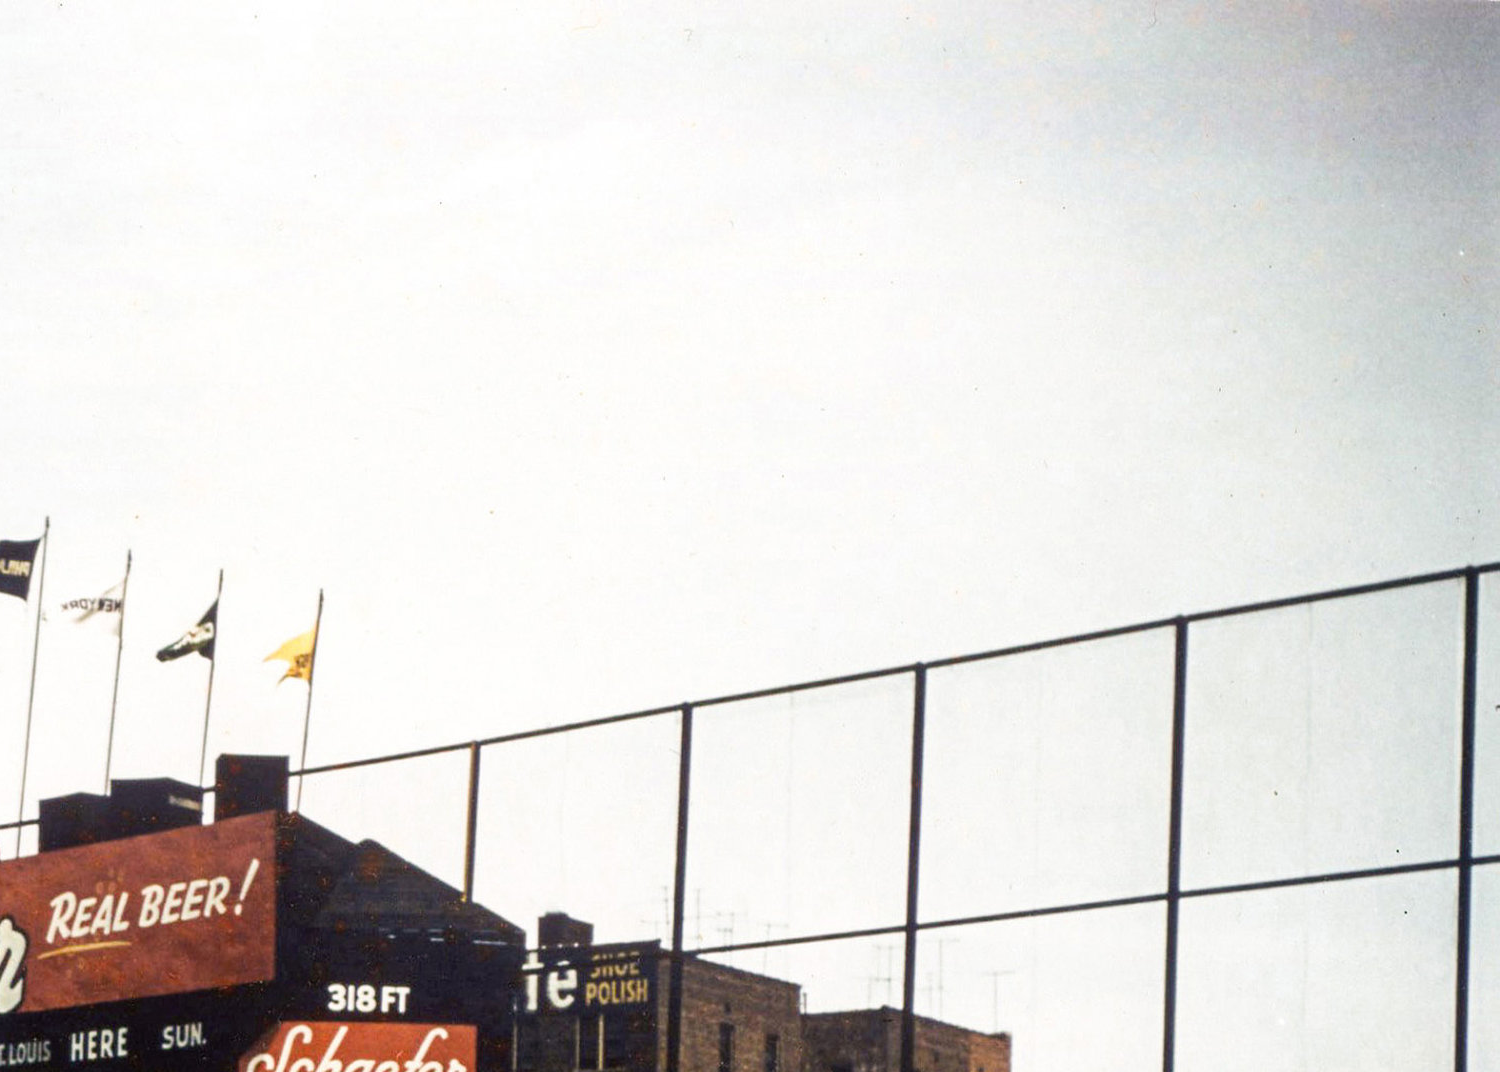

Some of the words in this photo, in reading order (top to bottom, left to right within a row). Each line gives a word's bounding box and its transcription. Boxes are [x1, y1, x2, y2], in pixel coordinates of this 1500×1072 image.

[46, 891, 130, 944] REAL
[138, 858, 260, 929] BEER!
[327, 983, 377, 1012] 318
[380, 986, 410, 1014] FT
[586, 979, 648, 1006] POLISH
[70, 1027, 128, 1062] HERE
[161, 1022, 207, 1050] SUN.
